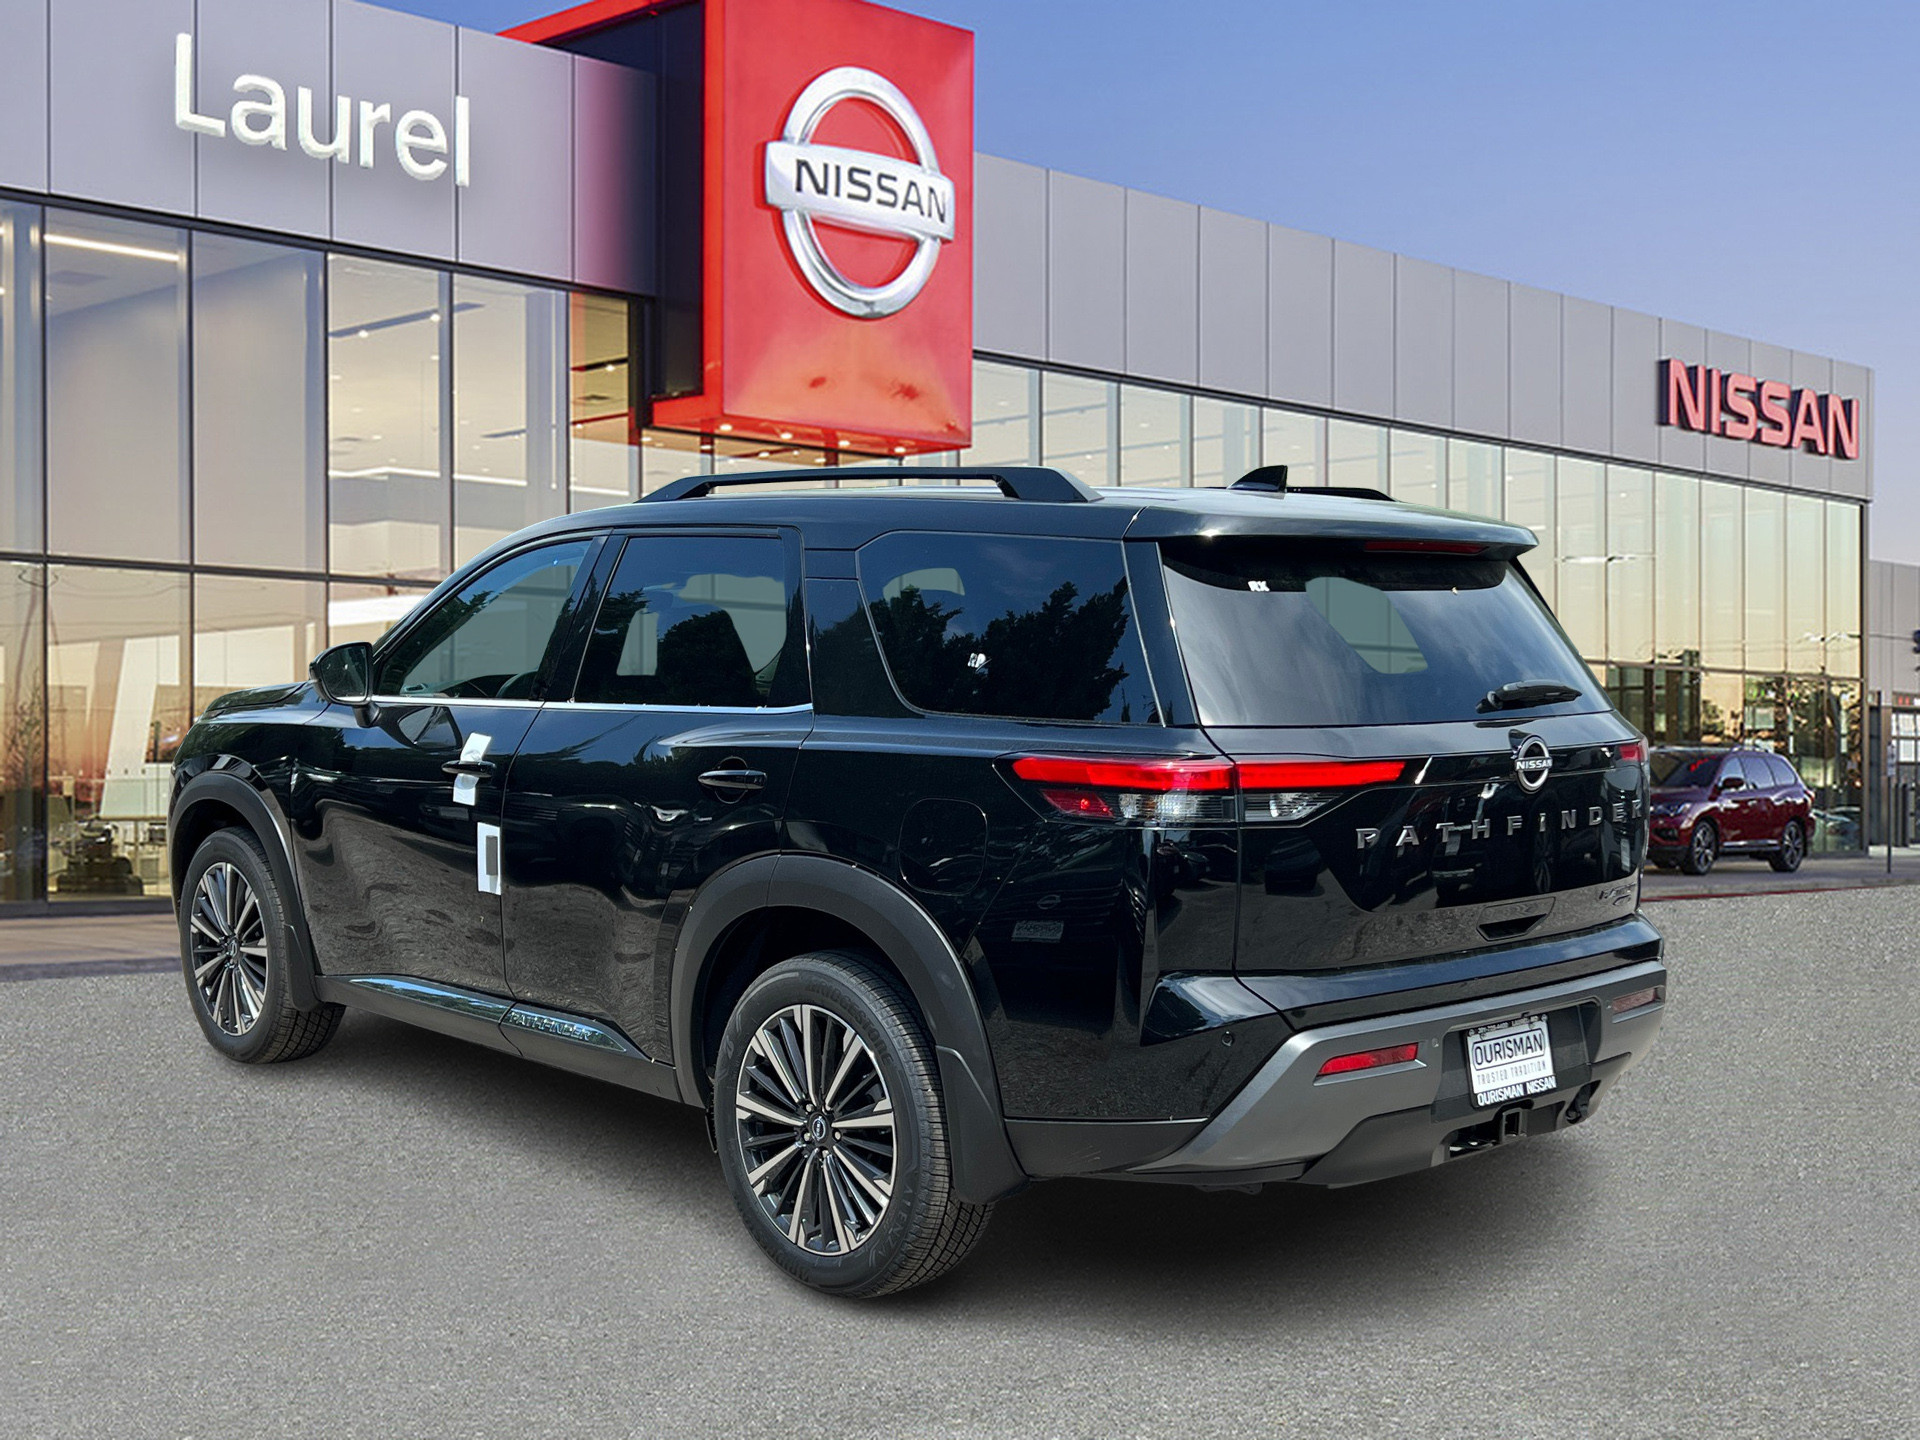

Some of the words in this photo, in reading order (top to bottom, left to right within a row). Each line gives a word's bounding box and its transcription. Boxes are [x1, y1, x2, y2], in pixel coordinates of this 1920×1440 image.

[175, 32, 470, 188] Laurel
[794, 158, 947, 224] NISSAN
[1657, 357, 1860, 460] NISSAN
[1516, 759, 1553, 770] NISSAN
[1355, 799, 1644, 850] PATHFINDER
[509, 1012, 590, 1041] PATHFINDER
[1474, 1033, 1543, 1066] OURISMAN
[1477, 1069, 1508, 1085] TRUSTED
[1510, 1060, 1547, 1078] TRADITION
[1477, 1083, 1525, 1107] OURISMAN
[1526, 1075, 1557, 1095] NISSAN
